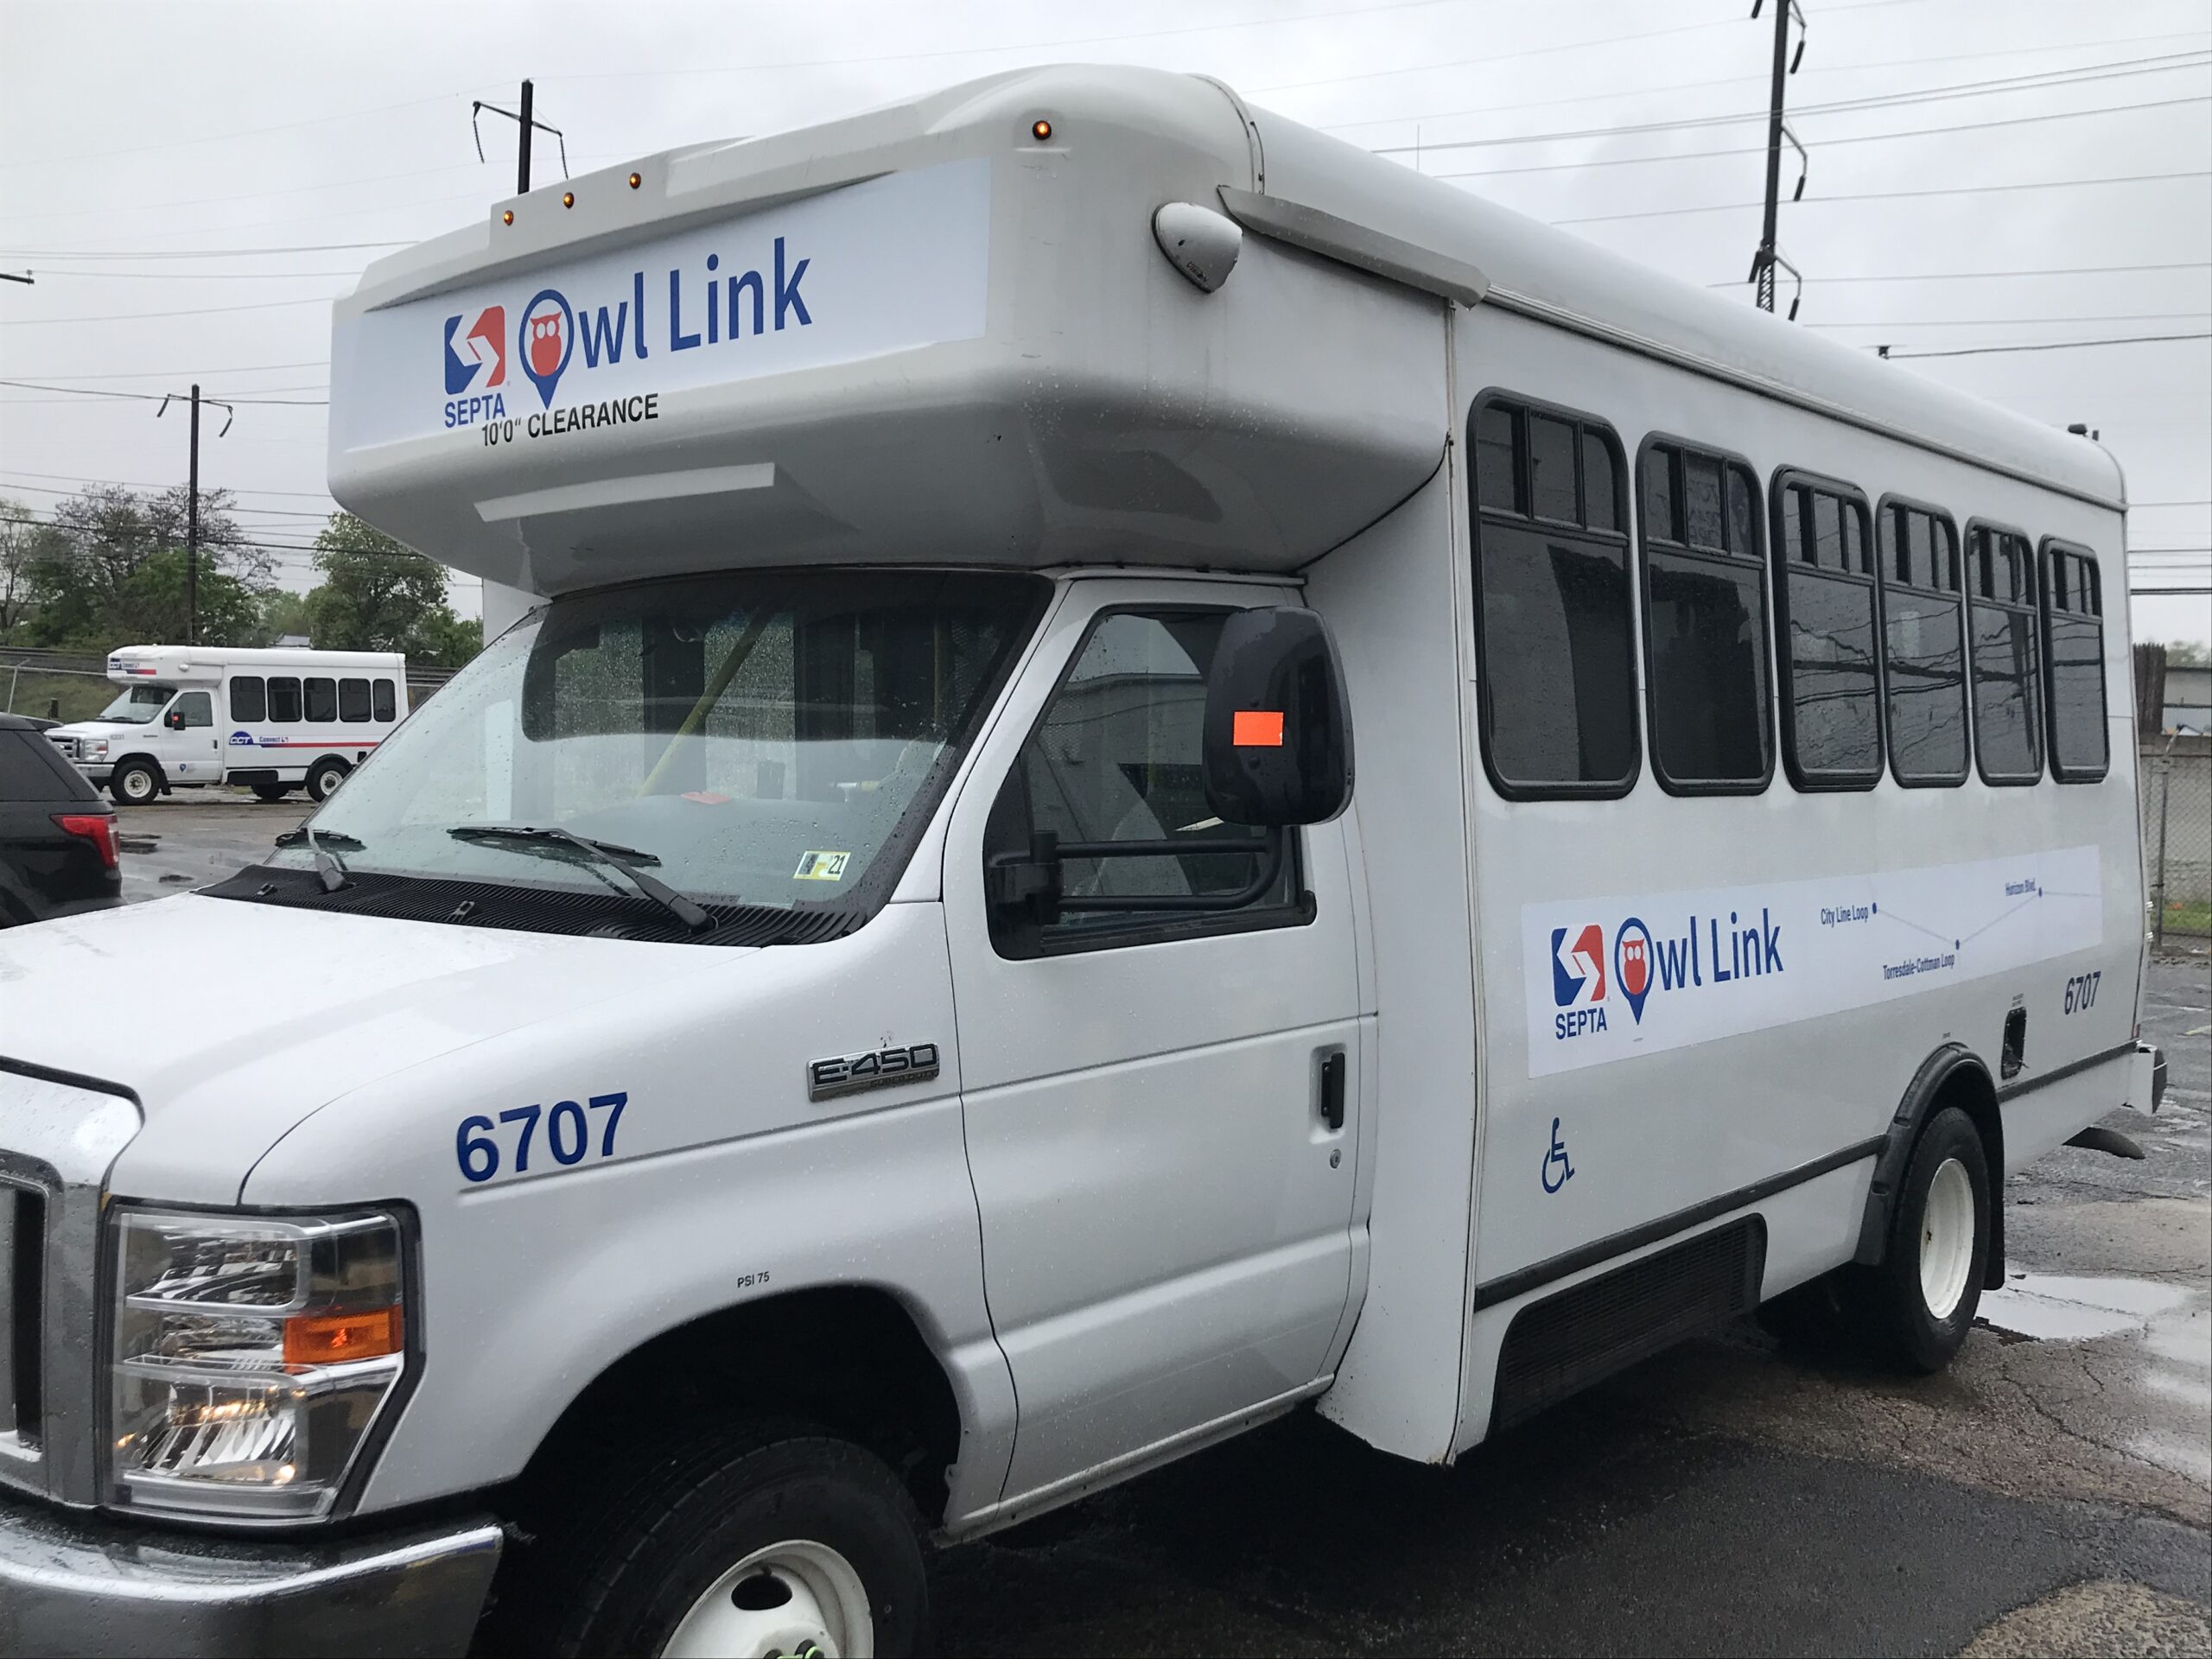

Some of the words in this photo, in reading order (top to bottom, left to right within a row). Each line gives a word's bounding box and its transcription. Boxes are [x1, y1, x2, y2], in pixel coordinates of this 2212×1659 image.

[518, 271, 649, 410] Owl
[670, 237, 813, 353] Link
[444, 393, 506, 429] SEPTA
[527, 393, 659, 439] CLEARANCE
[827, 855, 846, 874] 21
[1821, 907, 1835, 928] City
[1836, 906, 1851, 923] Line
[1852, 905, 1869, 923] Loop
[1614, 916, 1702, 1026] Owl
[1710, 907, 1784, 983] Link
[1941, 953, 1955, 969] Loop
[2064, 970, 2101, 1015] 6707
[1555, 1007, 1607, 1039] SEPTA
[456, 1091, 628, 1182] 6707
[737, 1274, 754, 1288] PSI
[757, 1270, 770, 1283] 75
